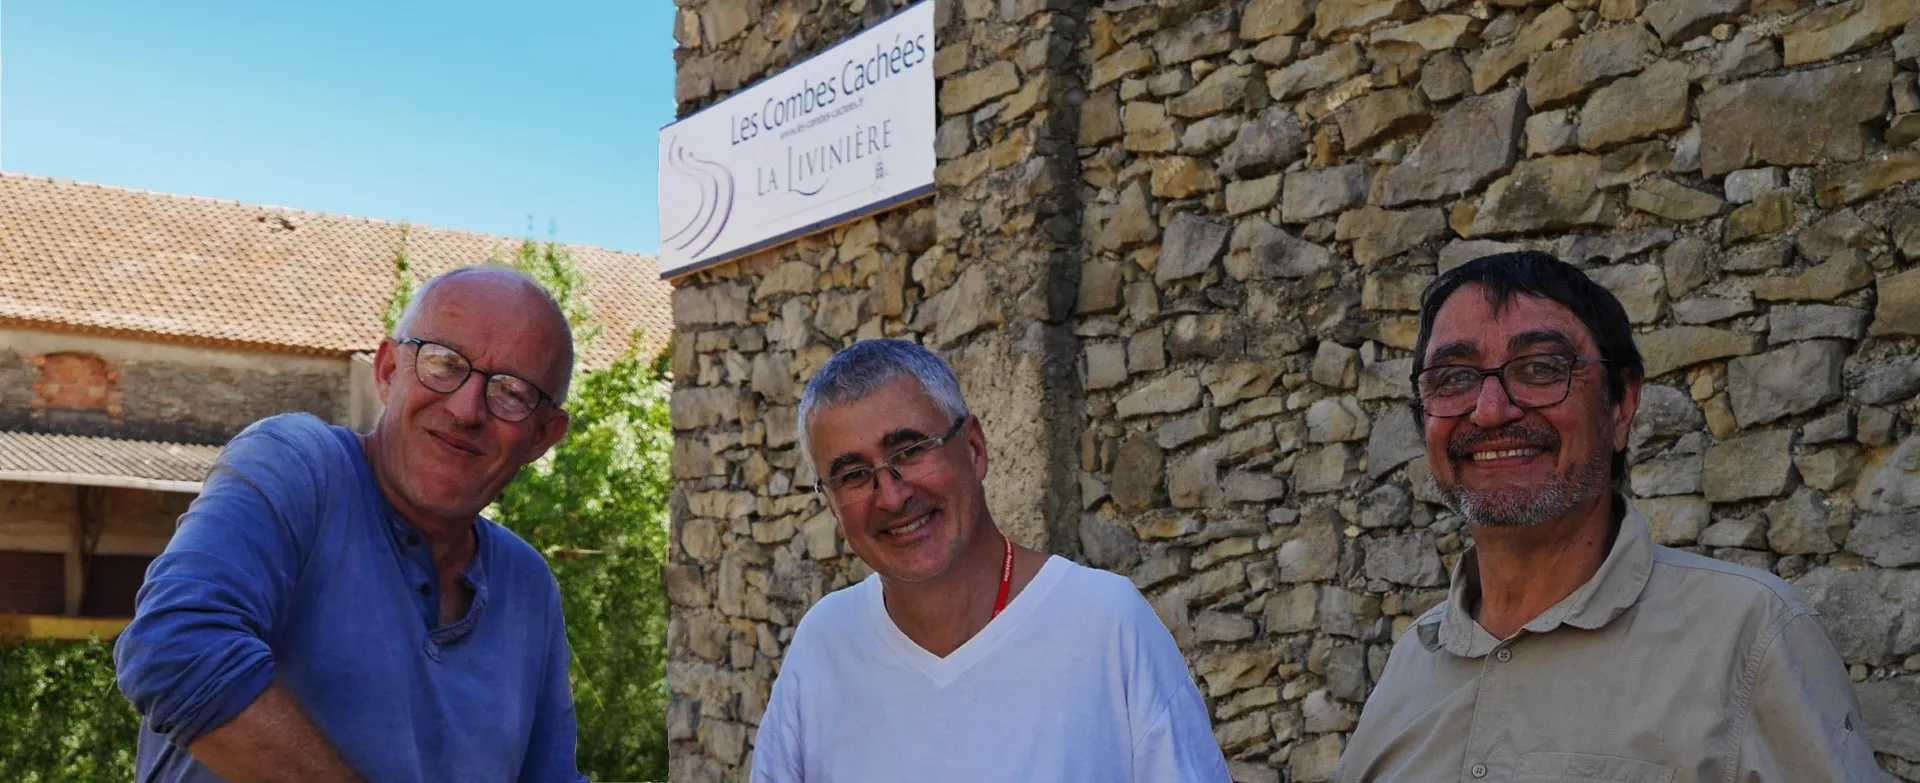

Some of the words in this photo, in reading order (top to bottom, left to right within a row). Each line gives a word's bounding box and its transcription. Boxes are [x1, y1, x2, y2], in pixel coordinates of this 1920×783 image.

[731, 113, 758, 145] Les
[763, 78, 836, 131] Combes
[841, 33, 926, 96] Cachées
[757, 166, 778, 196] LA
